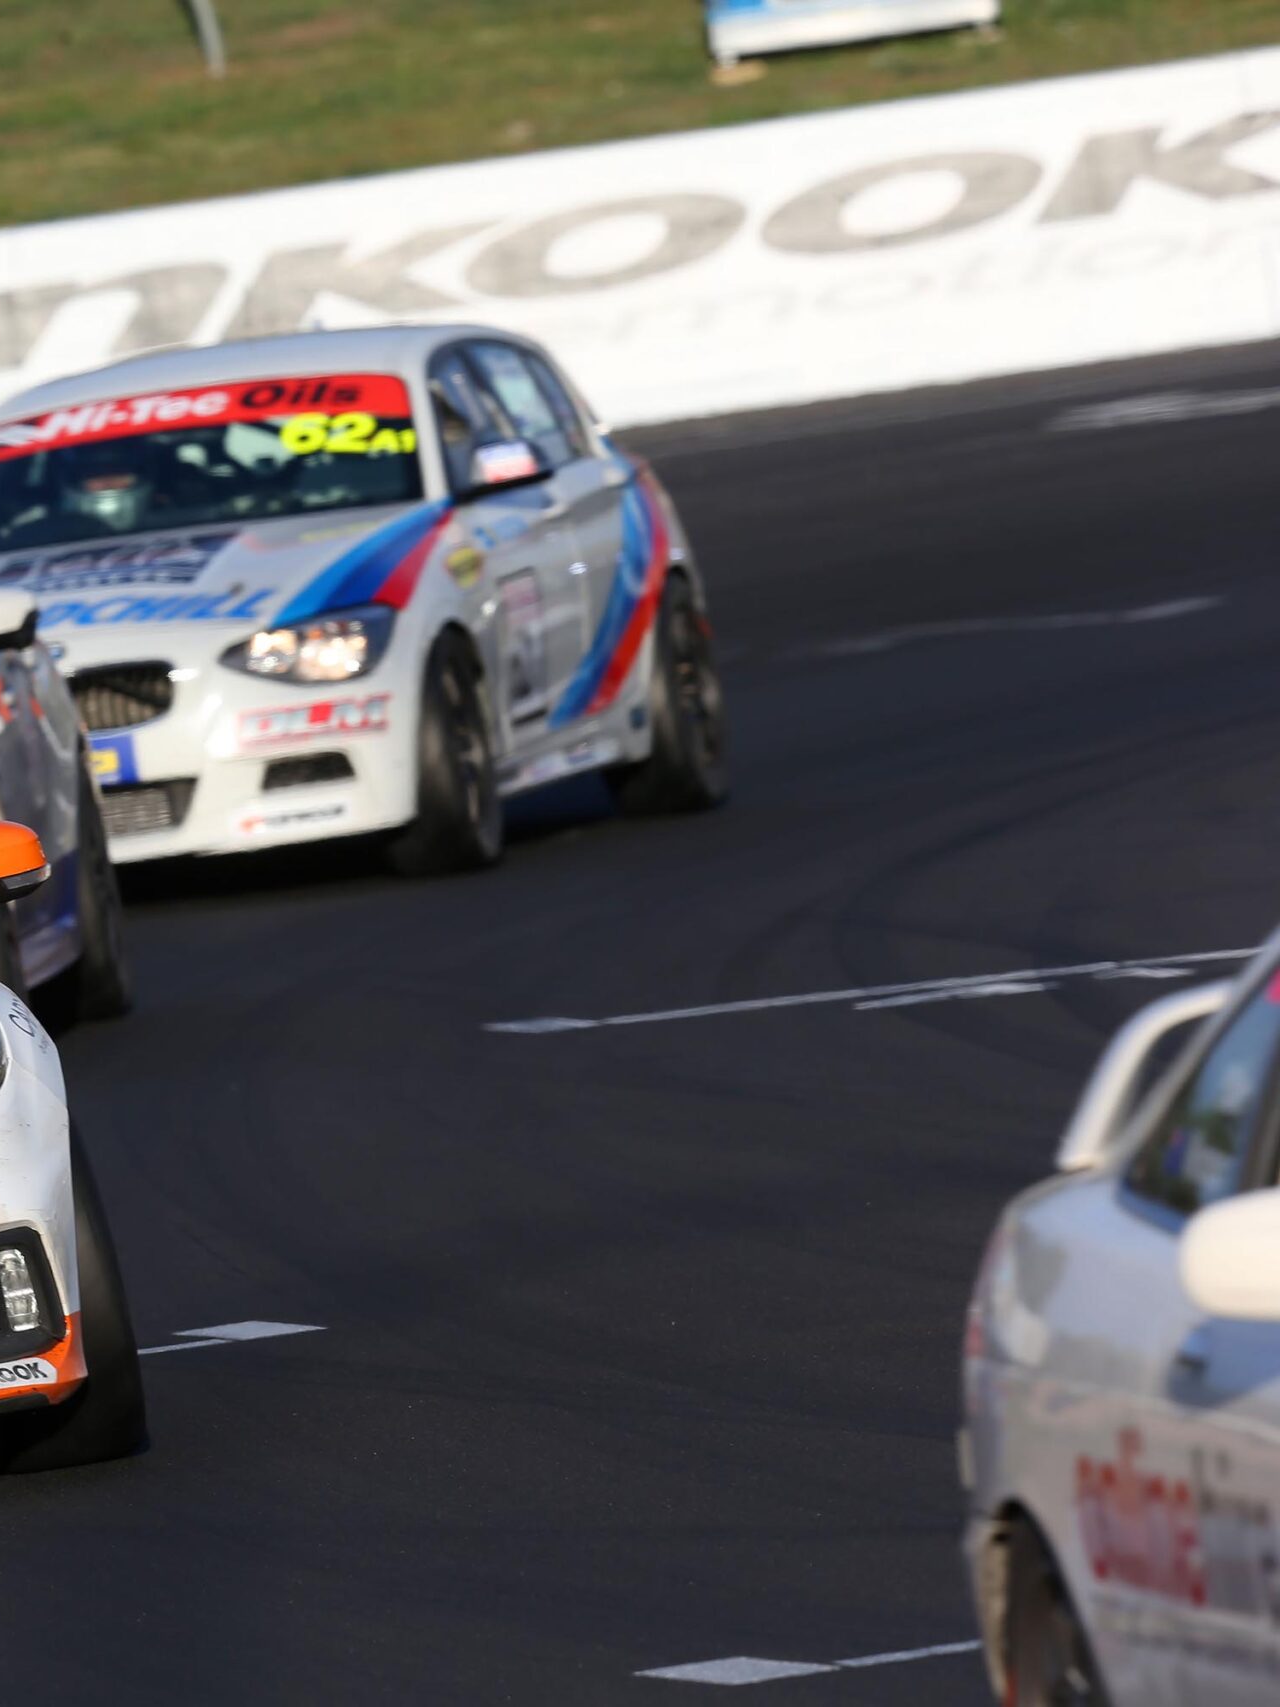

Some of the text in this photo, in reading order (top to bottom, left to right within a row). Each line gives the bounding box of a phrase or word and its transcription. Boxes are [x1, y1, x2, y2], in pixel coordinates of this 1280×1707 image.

[38, 377, 361, 440] Hi-Tec Oils
[280, 412, 378, 454] 62
